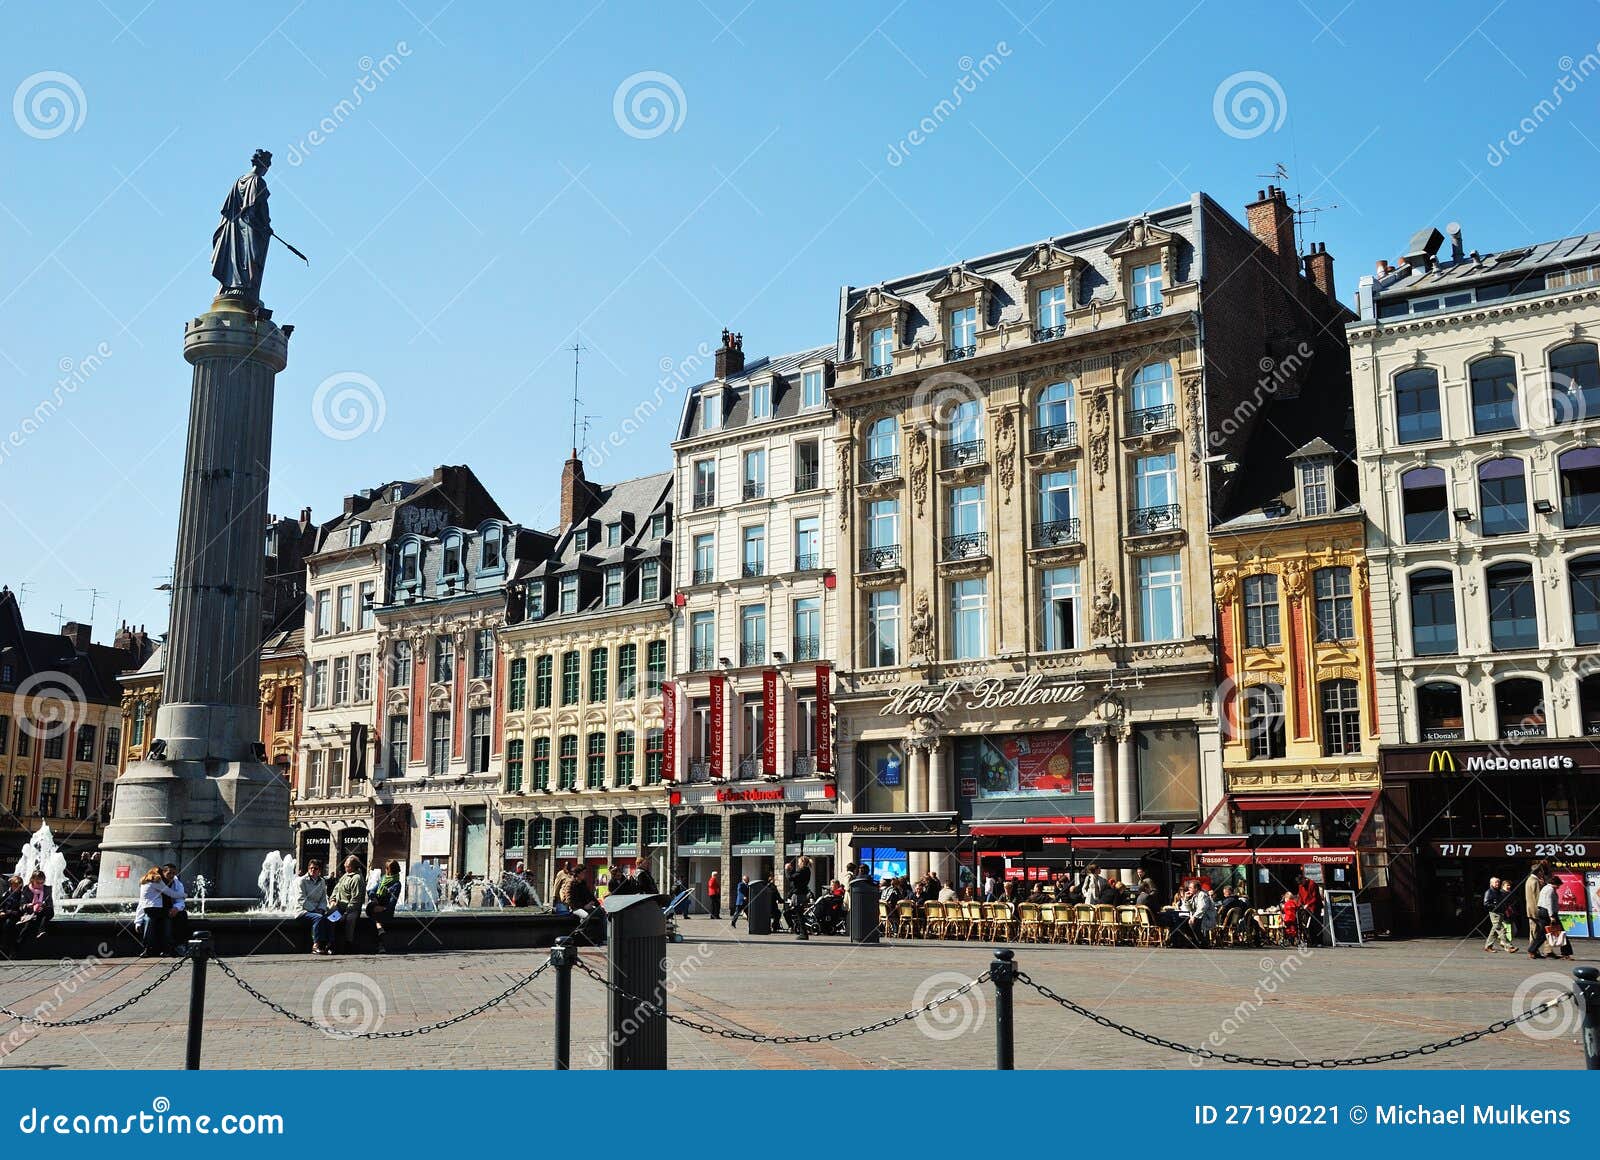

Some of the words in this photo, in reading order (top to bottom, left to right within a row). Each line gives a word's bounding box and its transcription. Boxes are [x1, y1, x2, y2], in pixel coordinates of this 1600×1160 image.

[879, 681, 960, 717] Hôtel
[966, 674, 1086, 709] Bellevue
[767, 709, 774, 723] du
[821, 706, 828, 719] du
[667, 717, 673, 730] du
[714, 714, 721, 727] du
[713, 731, 721, 755] furet
[766, 727, 774, 752] furet
[820, 723, 828, 750] furet
[713, 760, 721, 769] le
[766, 757, 774, 766] le
[821, 755, 828, 763] le
[1467, 755, 1574, 771] McDonald's
[665, 763, 673, 772] le
[1312, 855, 1349, 863] Restaurant
